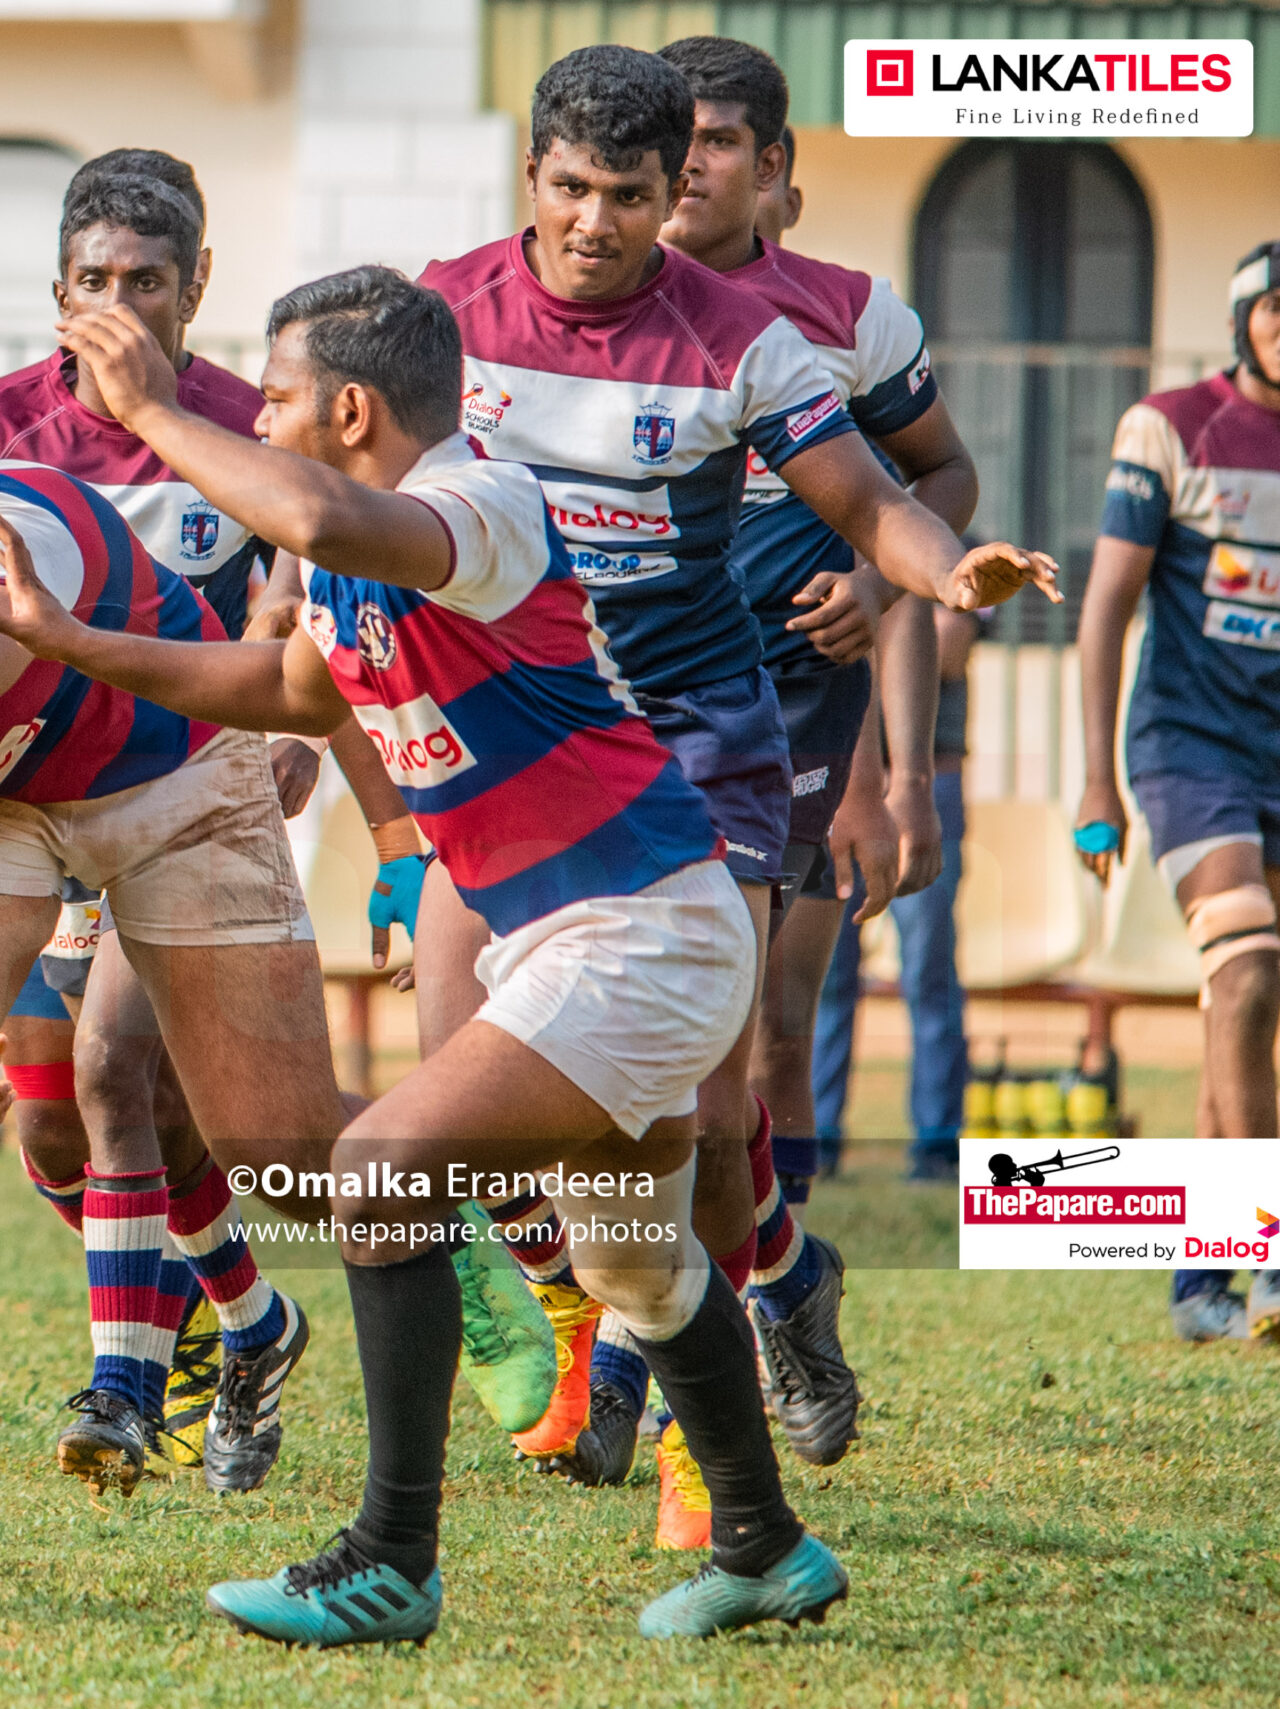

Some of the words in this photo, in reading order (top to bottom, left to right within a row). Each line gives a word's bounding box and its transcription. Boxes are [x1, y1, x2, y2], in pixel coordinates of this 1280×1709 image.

[468, 397, 504, 420] Dialog
[465, 411, 500, 429] SCHOOLS
[468, 421, 494, 435] RUGBY
